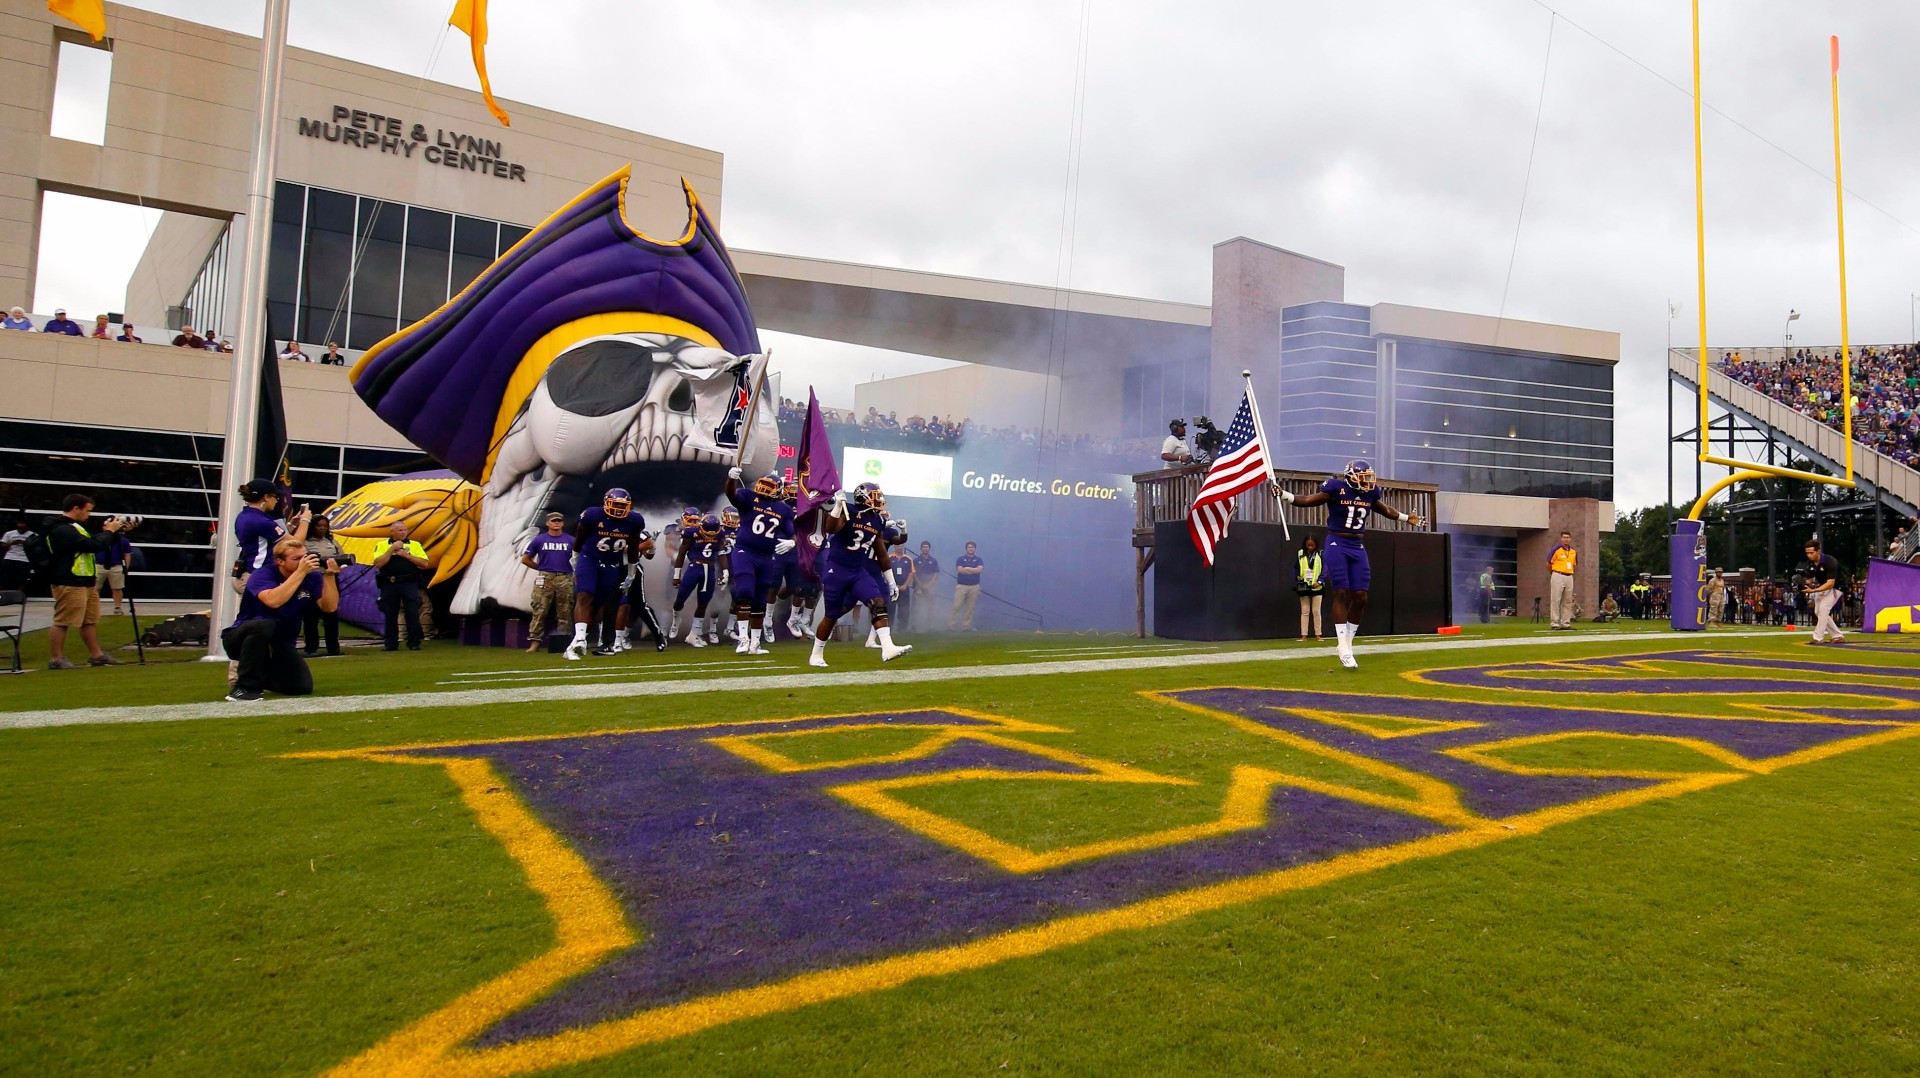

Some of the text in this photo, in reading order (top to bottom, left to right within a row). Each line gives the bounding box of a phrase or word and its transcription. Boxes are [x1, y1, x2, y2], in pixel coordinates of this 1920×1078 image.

[333, 105, 502, 159] PETE & LYNN
[299, 116, 527, 182] MURPHY CENTER
[962, 471, 985, 489] Go
[988, 473, 1046, 494] Pirates.
[1051, 479, 1071, 496] Go
[752, 513, 780, 539] 62
[1345, 505, 1367, 530] 13
[541, 542, 569, 551] ARMY
[701, 542, 713, 558] 6
